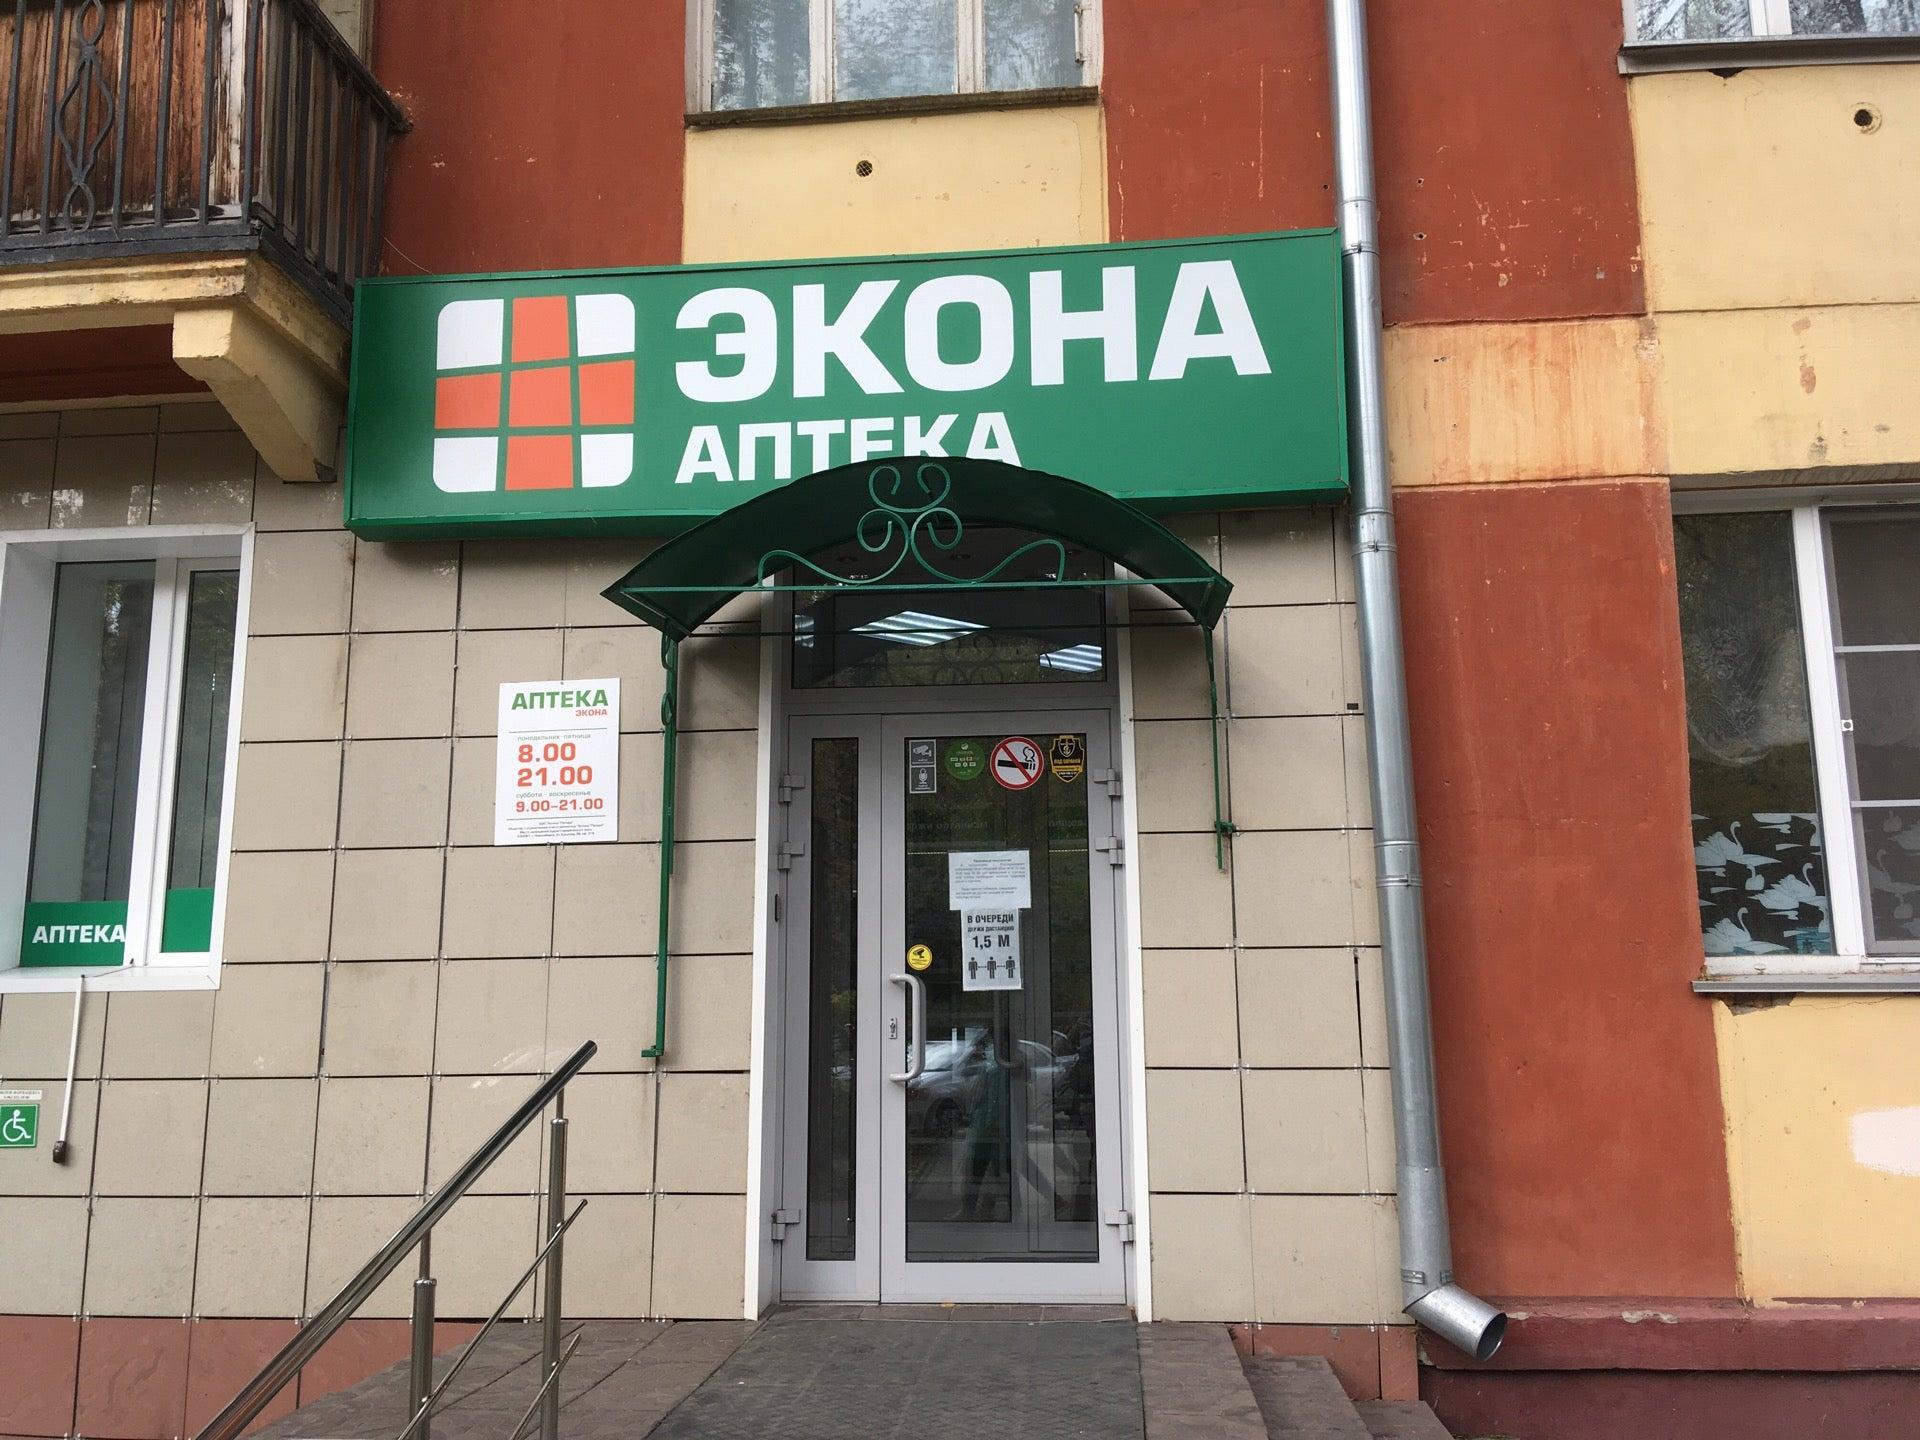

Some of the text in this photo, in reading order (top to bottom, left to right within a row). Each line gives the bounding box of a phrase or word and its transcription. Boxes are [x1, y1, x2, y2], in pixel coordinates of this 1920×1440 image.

[674, 259, 1272, 403] ЭКОНА
[674, 411, 1022, 484] АПТЕКА
[511, 690, 608, 710] АПТЕКА
[575, 708, 608, 717] ЭКОНА
[518, 742, 577, 763] 8.00
[517, 765, 593, 787] 21.00
[515, 791, 543, 799] суббота
[516, 798, 604, 813] 9.00-21.00
[967, 914, 1014, 924] В ОЧЕРЕДИ
[32, 924, 126, 944] АПТЕКА
[972, 934, 1010, 950] 1,5 М
